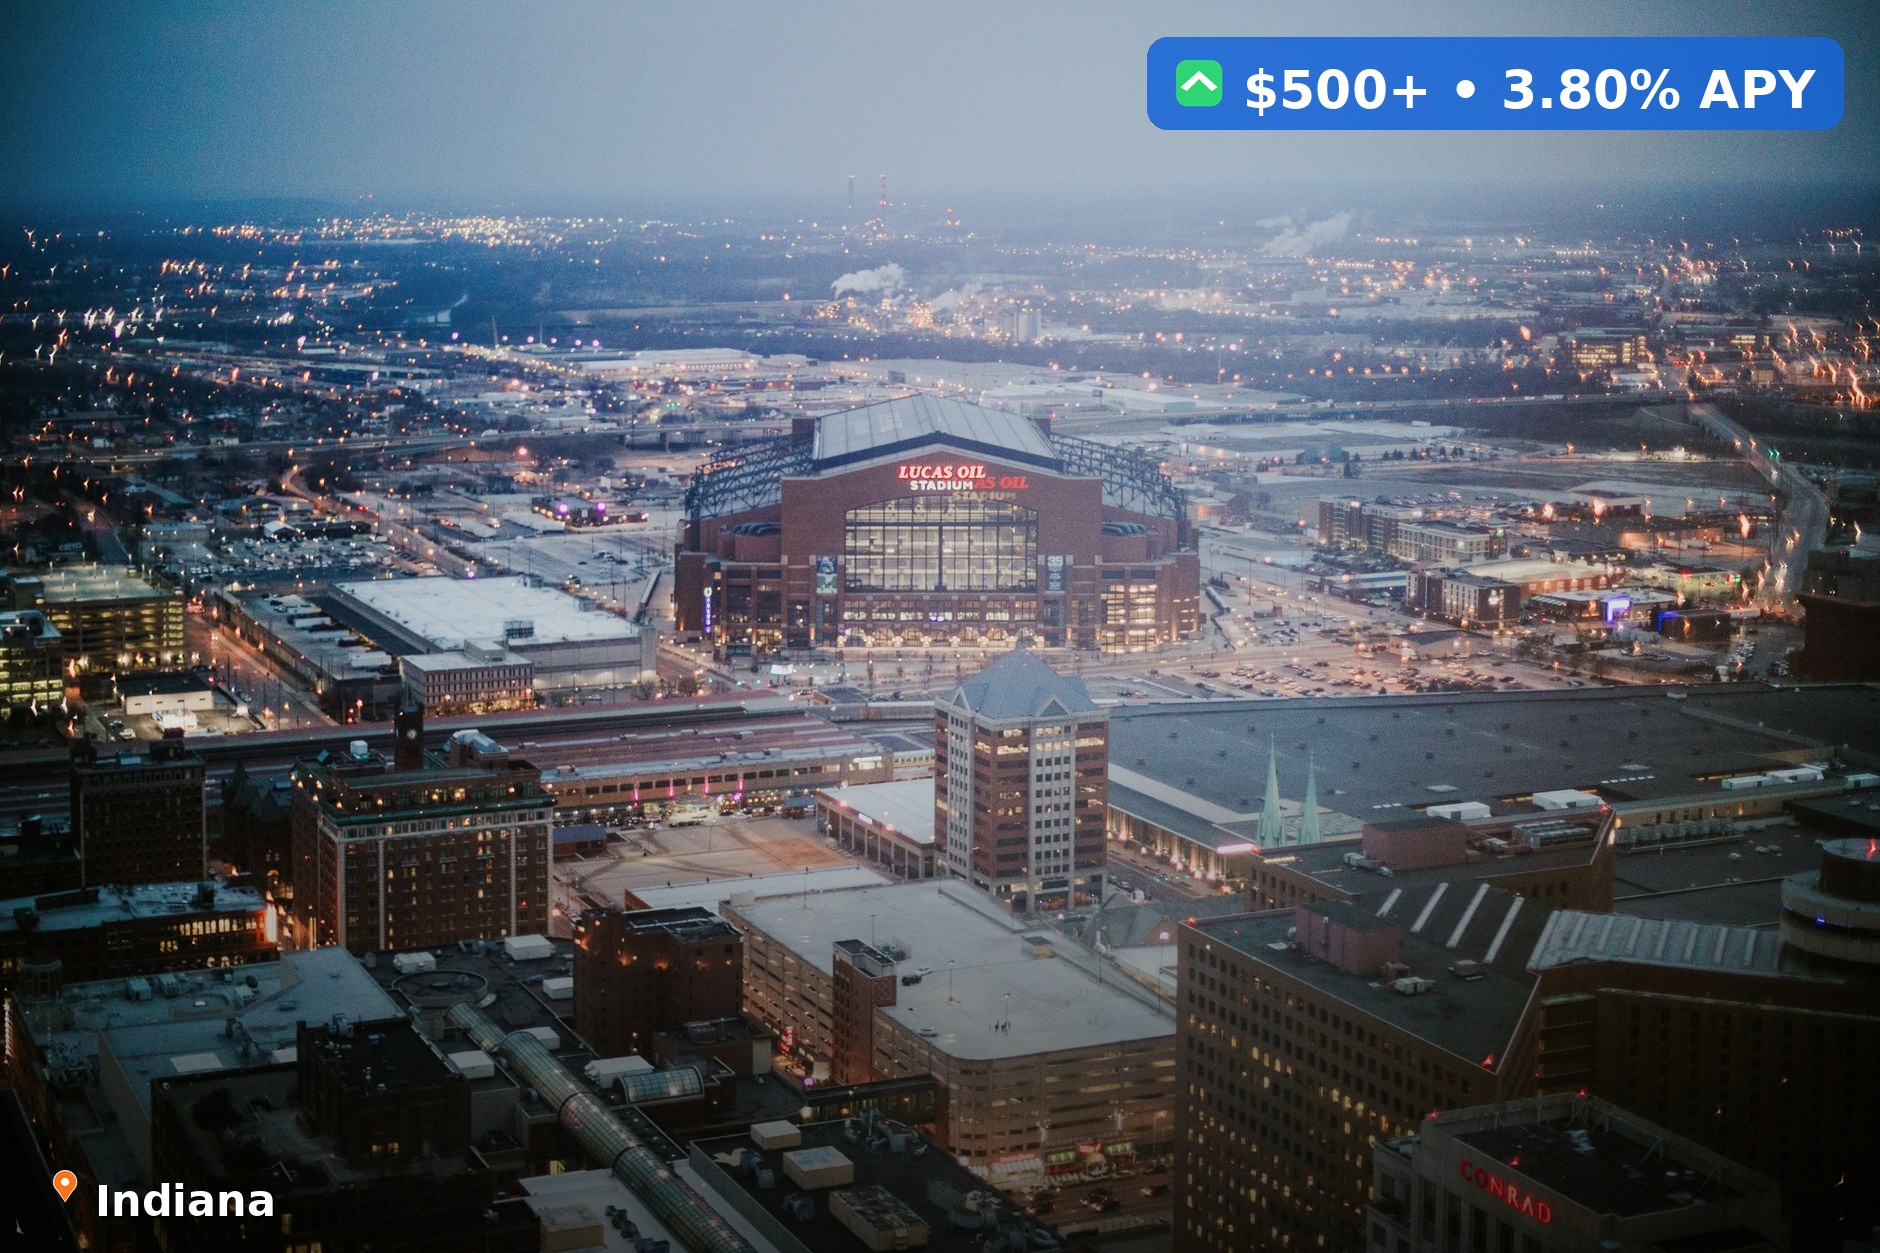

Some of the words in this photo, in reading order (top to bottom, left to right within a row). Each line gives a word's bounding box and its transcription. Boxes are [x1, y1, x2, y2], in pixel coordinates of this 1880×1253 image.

[898, 465, 953, 479] LUCAS
[957, 465, 986, 479] OIL
[910, 480, 973, 491] STADIUM
[1459, 1159, 1552, 1224] CONRAD
